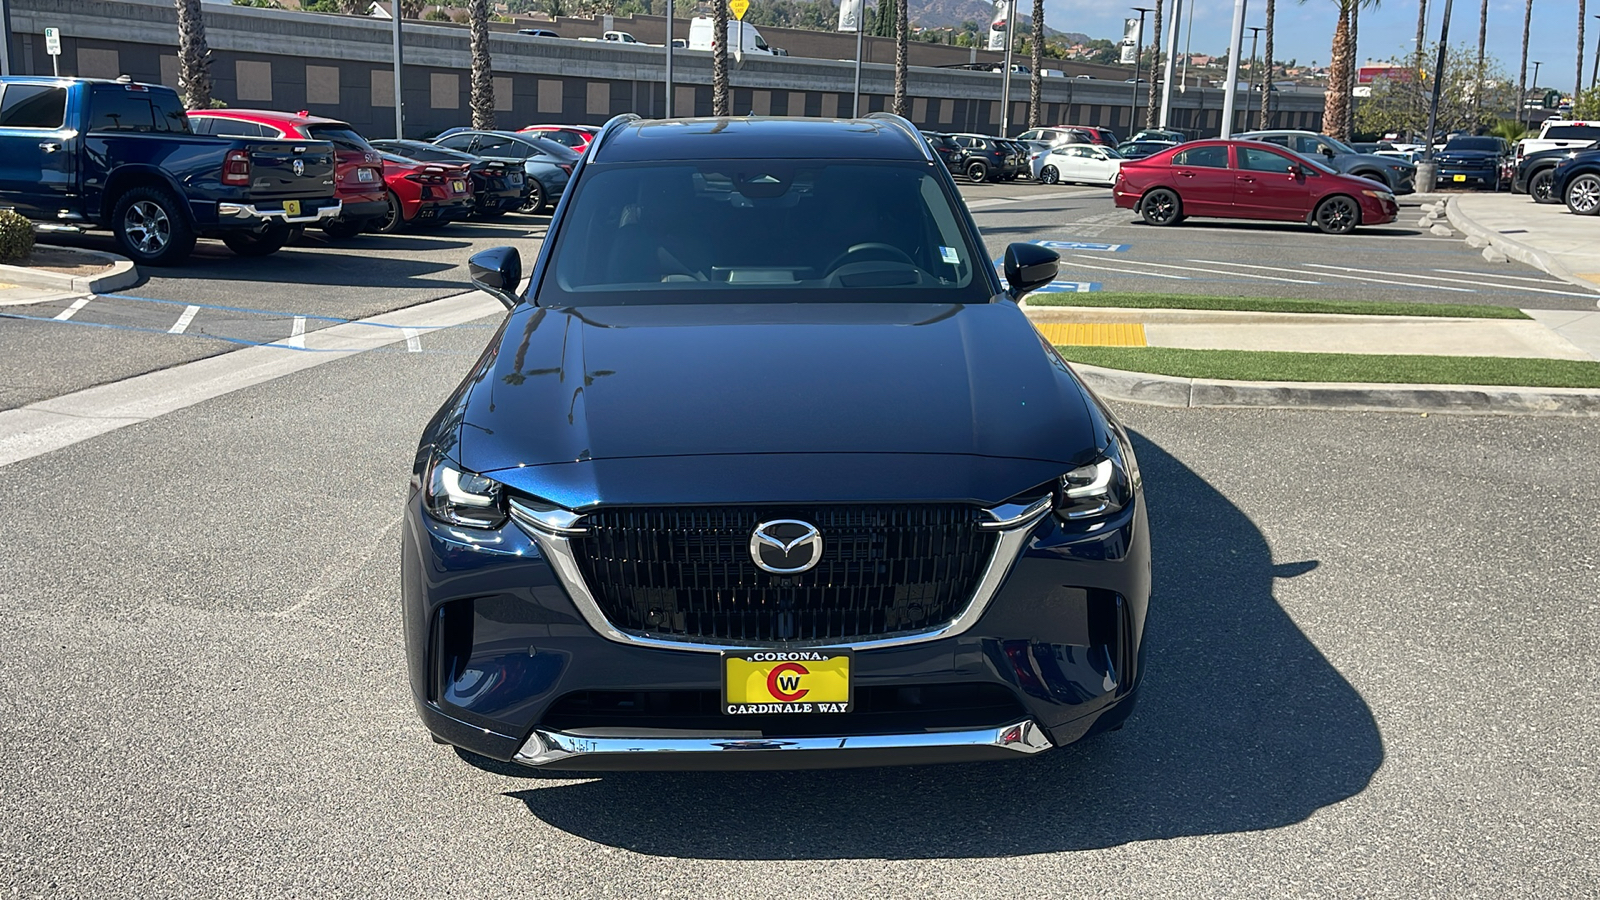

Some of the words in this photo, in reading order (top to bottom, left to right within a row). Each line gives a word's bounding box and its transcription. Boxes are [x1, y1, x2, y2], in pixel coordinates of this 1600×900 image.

[753, 652, 821, 661] CORONA
[778, 675, 801, 691] W
[727, 703, 813, 715] CARDINALE
[818, 703, 849, 713] WAY
